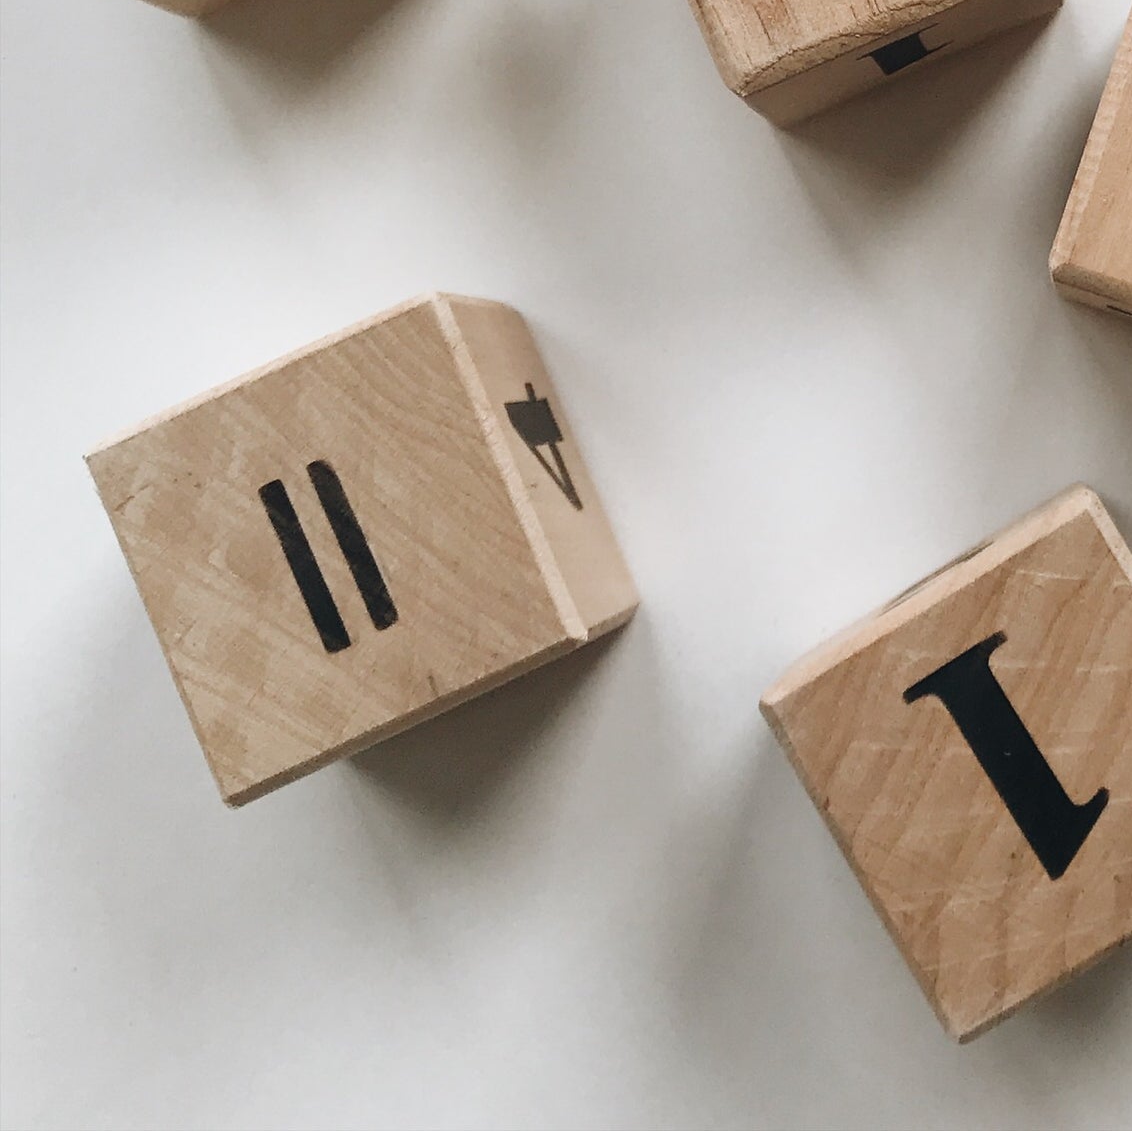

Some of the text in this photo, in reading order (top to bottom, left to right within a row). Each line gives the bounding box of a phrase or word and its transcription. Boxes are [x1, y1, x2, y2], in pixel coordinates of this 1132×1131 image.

[856, 23, 954, 76] 1
[504, 382, 583, 511] 4
[903, 631, 1109, 881] 1
